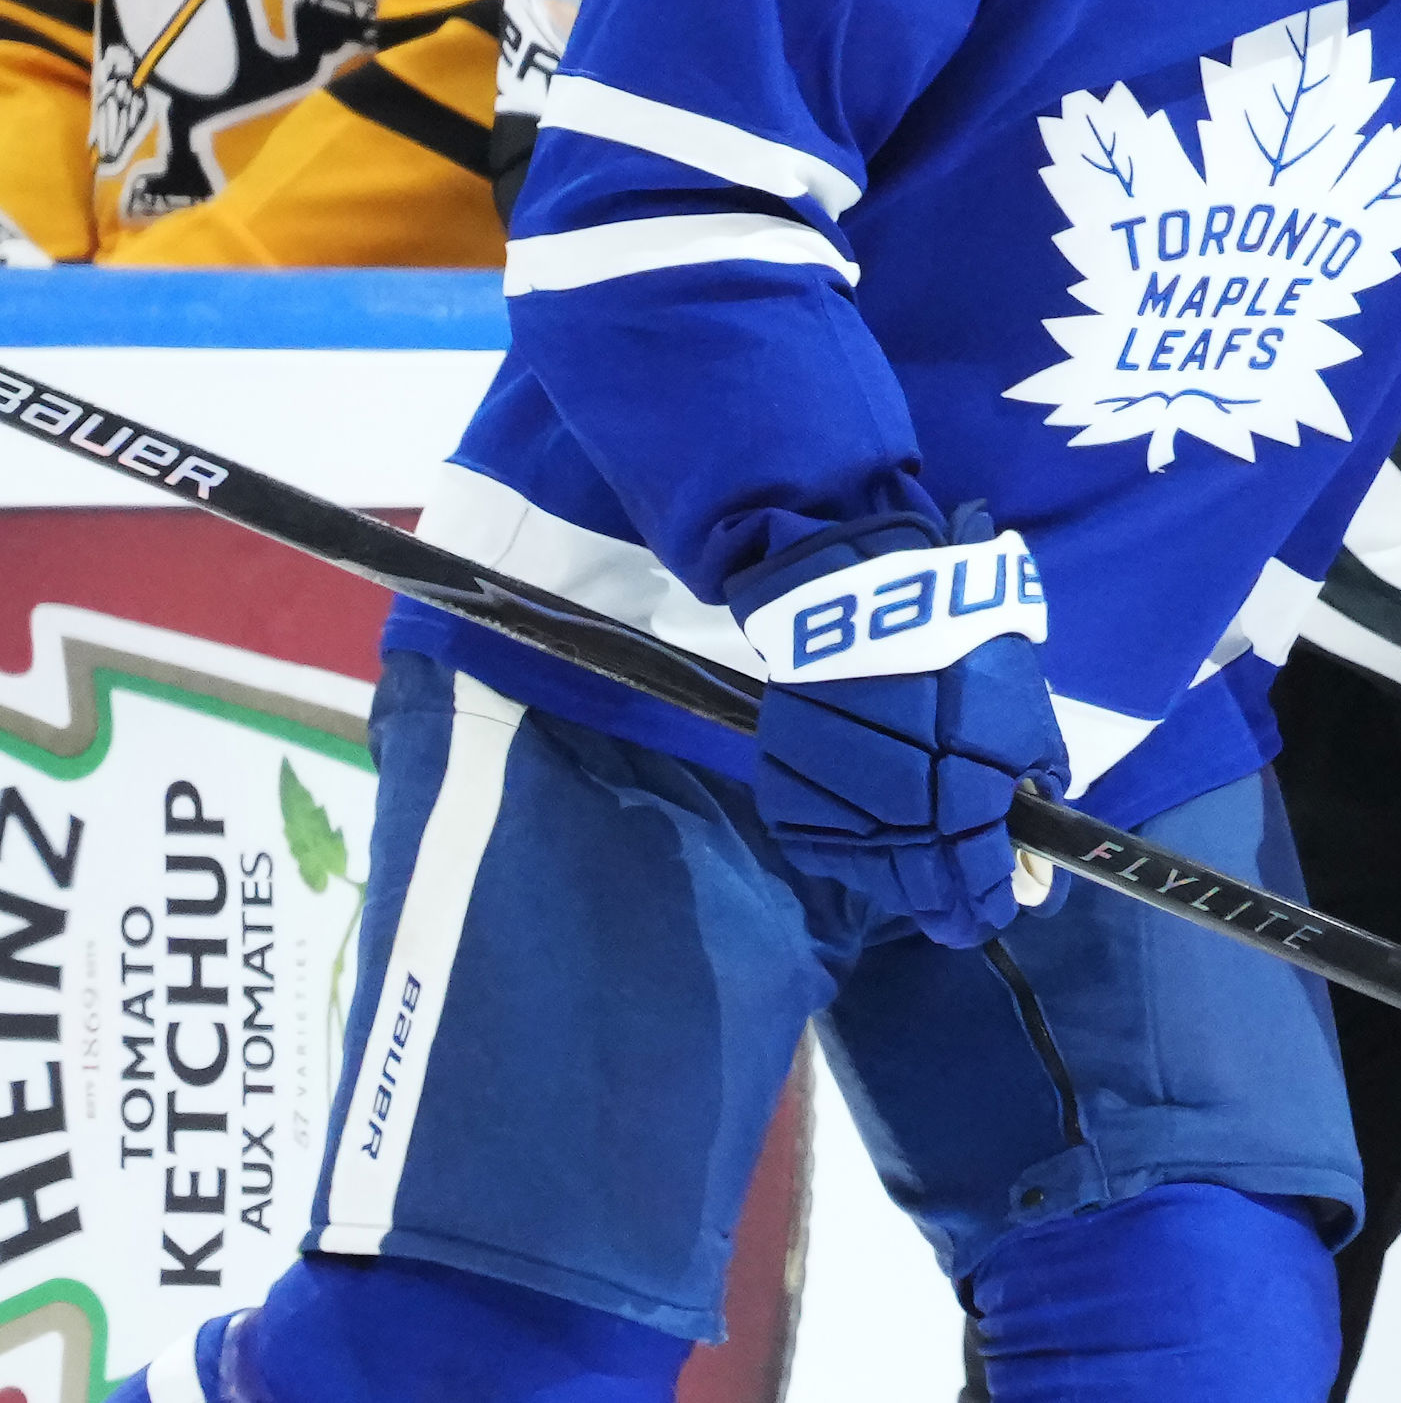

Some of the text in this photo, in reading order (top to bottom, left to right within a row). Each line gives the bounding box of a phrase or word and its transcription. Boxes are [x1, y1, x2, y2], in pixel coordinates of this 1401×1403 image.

[1110, 203, 1363, 281] TORONTO
[1137, 272, 1314, 318] MAPLE
[1115, 327, 1286, 372] LEAFS
[1081, 840, 1323, 952] FLYLITE
[120, 904, 155, 1170] TOMATO
[160, 779, 229, 1286] KETCHUP
[240, 850, 275, 1235] AUX TOMATES
[361, 972, 420, 1160] BAUER
